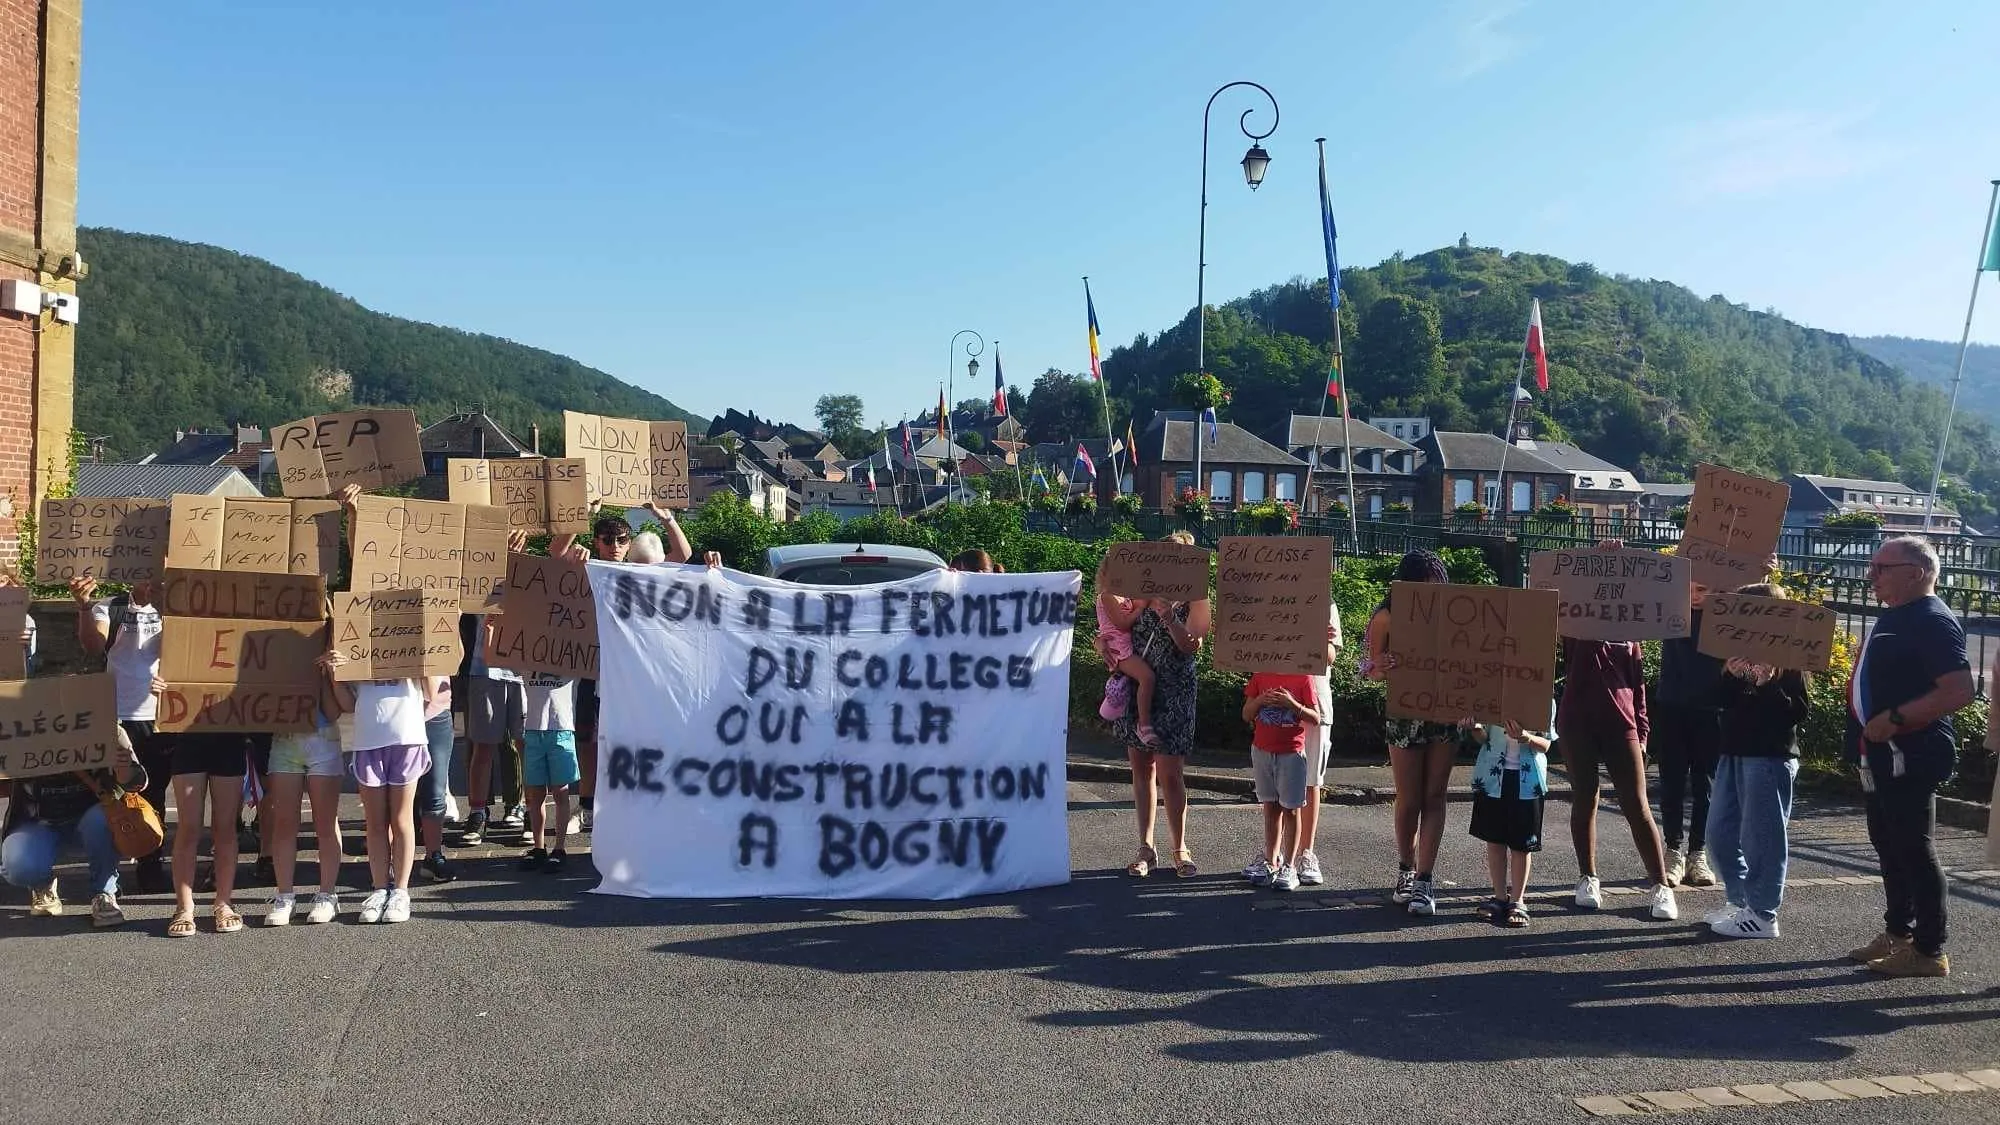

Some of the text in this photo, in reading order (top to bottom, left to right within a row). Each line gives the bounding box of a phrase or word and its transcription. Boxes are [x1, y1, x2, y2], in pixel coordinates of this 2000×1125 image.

[280, 418, 380, 451] REP
[579, 423, 687, 453] NON AUX
[458, 461, 582, 482] DÉLOCALISE
[605, 454, 681, 477] CLASSES
[503, 485, 536, 501] PAS
[46, 501, 150, 519] BOGNY
[186, 508, 220, 521] JE
[510, 503, 587, 526] COLLÈGE
[1712, 497, 1749, 517] PAS
[47, 521, 158, 540] 25 ELEVES
[387, 507, 452, 535] OUI
[1719, 522, 1753, 541] MON
[231, 532, 275, 543] MON
[41, 544, 153, 560] MONTHERME
[201, 548, 306, 568] AVENIR
[1225, 542, 1314, 563] EN CLASSE
[41, 563, 75, 582] 30
[511, 562, 547, 594] LA
[1223, 568, 1272, 582] COMME
[1553, 553, 1673, 583] PARENTS
[371, 572, 504, 596] PRIORITAIRE
[1141, 580, 1192, 594] BOGNY
[1594, 583, 1626, 600] EN
[346, 596, 458, 614] MONTHERME
[548, 602, 587, 629] PAS
[615, 574, 1078, 638] NON A LA FERMETURE
[1410, 591, 1509, 632] NON
[1559, 601, 1646, 622] COLERE
[1803, 610, 1824, 622] LA
[369, 625, 424, 637] CLASSES
[1715, 623, 1823, 650] PETITION
[209, 629, 277, 671] EN
[496, 626, 526, 662] LA
[1480, 633, 1517, 656] LA
[1234, 649, 1296, 662] SARDINE
[746, 647, 1034, 699] DU COLLEGE
[1454, 679, 1478, 690] DU
[160, 690, 317, 727] DANGER
[716, 698, 954, 745] OUI A LA
[23, 743, 106, 769] BOGNY
[607, 746, 1048, 809] RECONSTRUCTION
[738, 811, 1006, 878] A BOGNY
